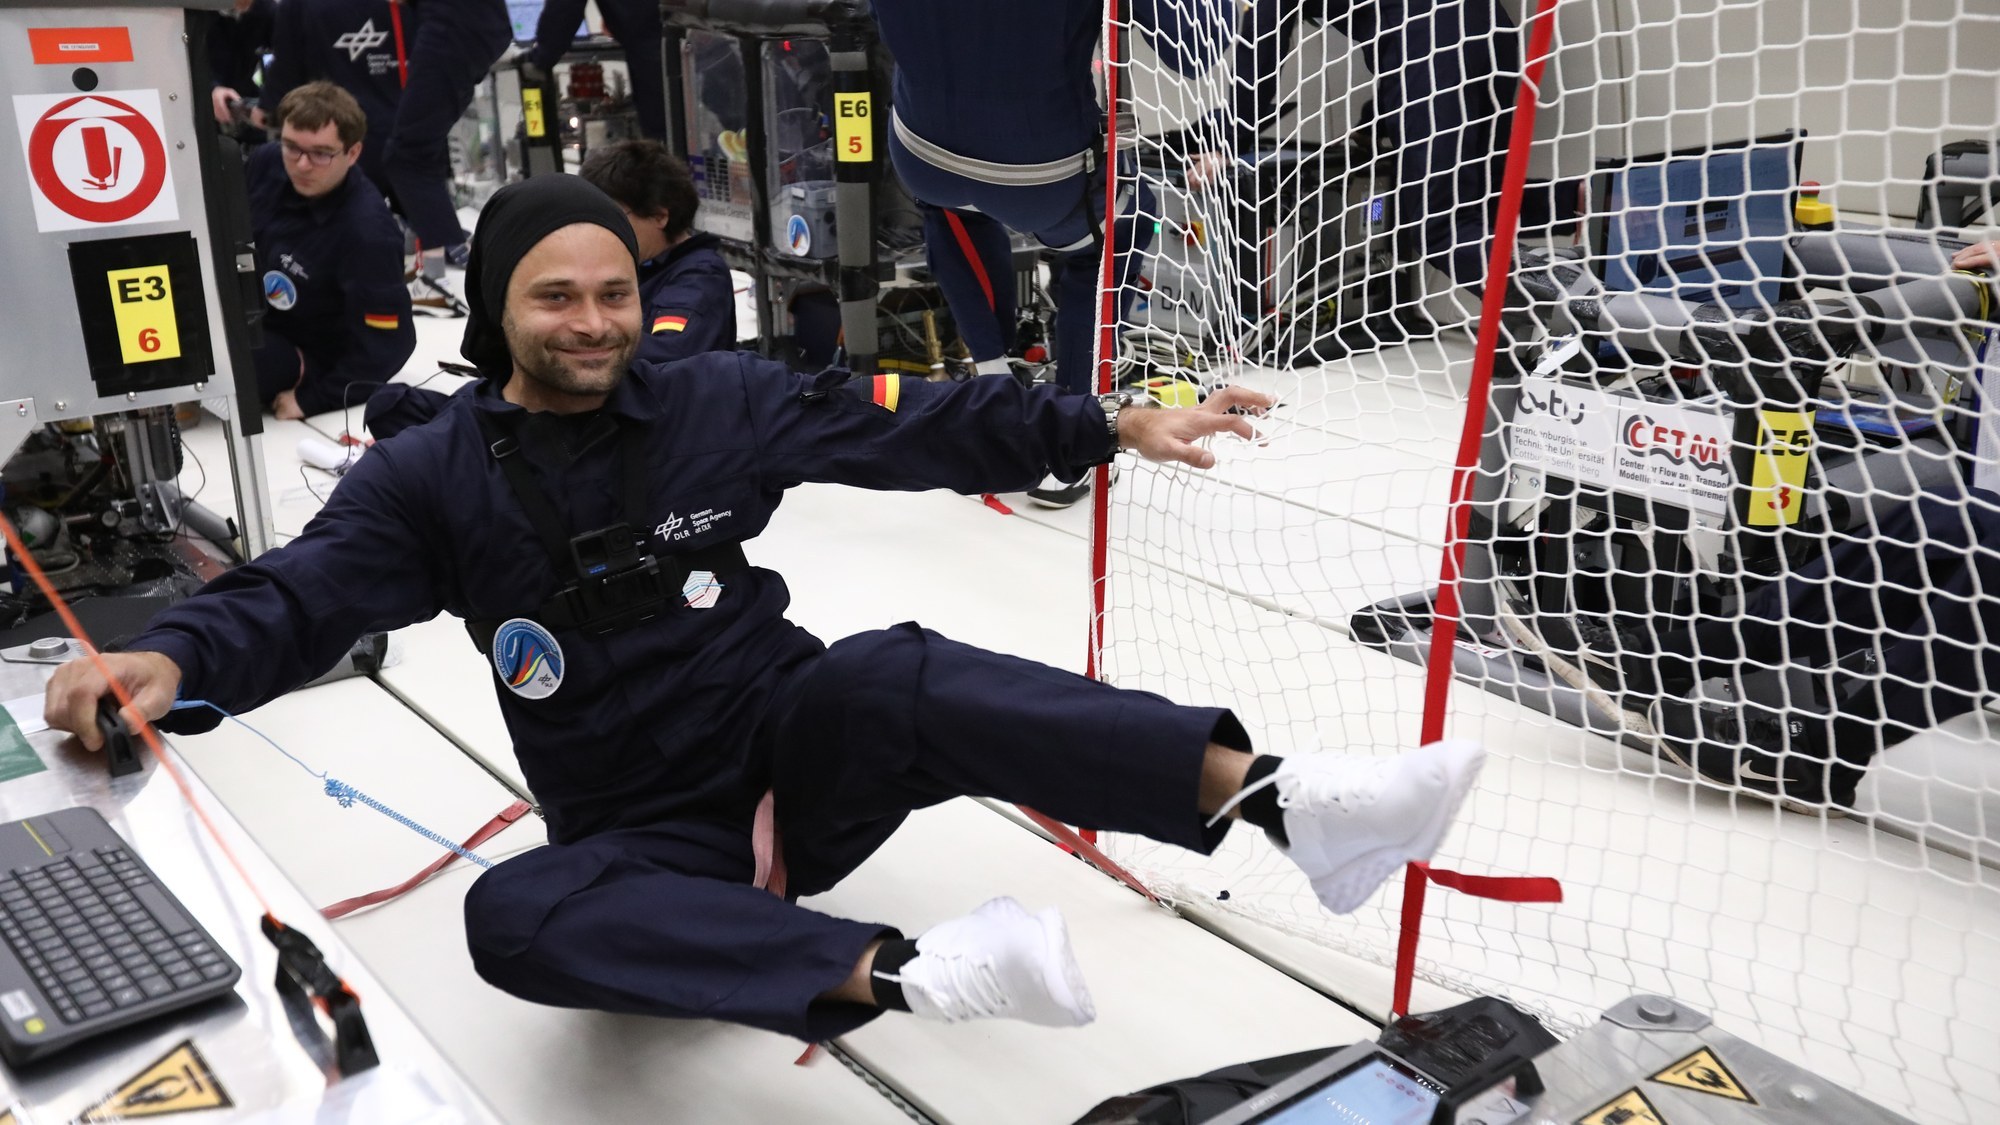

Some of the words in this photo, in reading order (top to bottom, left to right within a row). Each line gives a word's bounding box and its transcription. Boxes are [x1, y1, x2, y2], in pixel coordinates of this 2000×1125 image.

[840, 99, 868, 118] E6
[530, 120, 539, 131] 7
[849, 136, 862, 154] 5
[117, 276, 166, 304] E3
[138, 328, 161, 353] 6
[1760, 428, 1810, 457] E5
[1513, 447, 1543, 461] Cottbu
[1560, 446, 1605, 465] Uniersität
[1620, 457, 1645, 470] Center
[1659, 466, 1678, 478] Flow
[1696, 475, 1728, 489] Transpo
[1767, 484, 1791, 511] 3
[690, 508, 713, 520] German
[692, 517, 709, 527] Space
[709, 510, 732, 522] Agency
[673, 529, 691, 541] DLR
